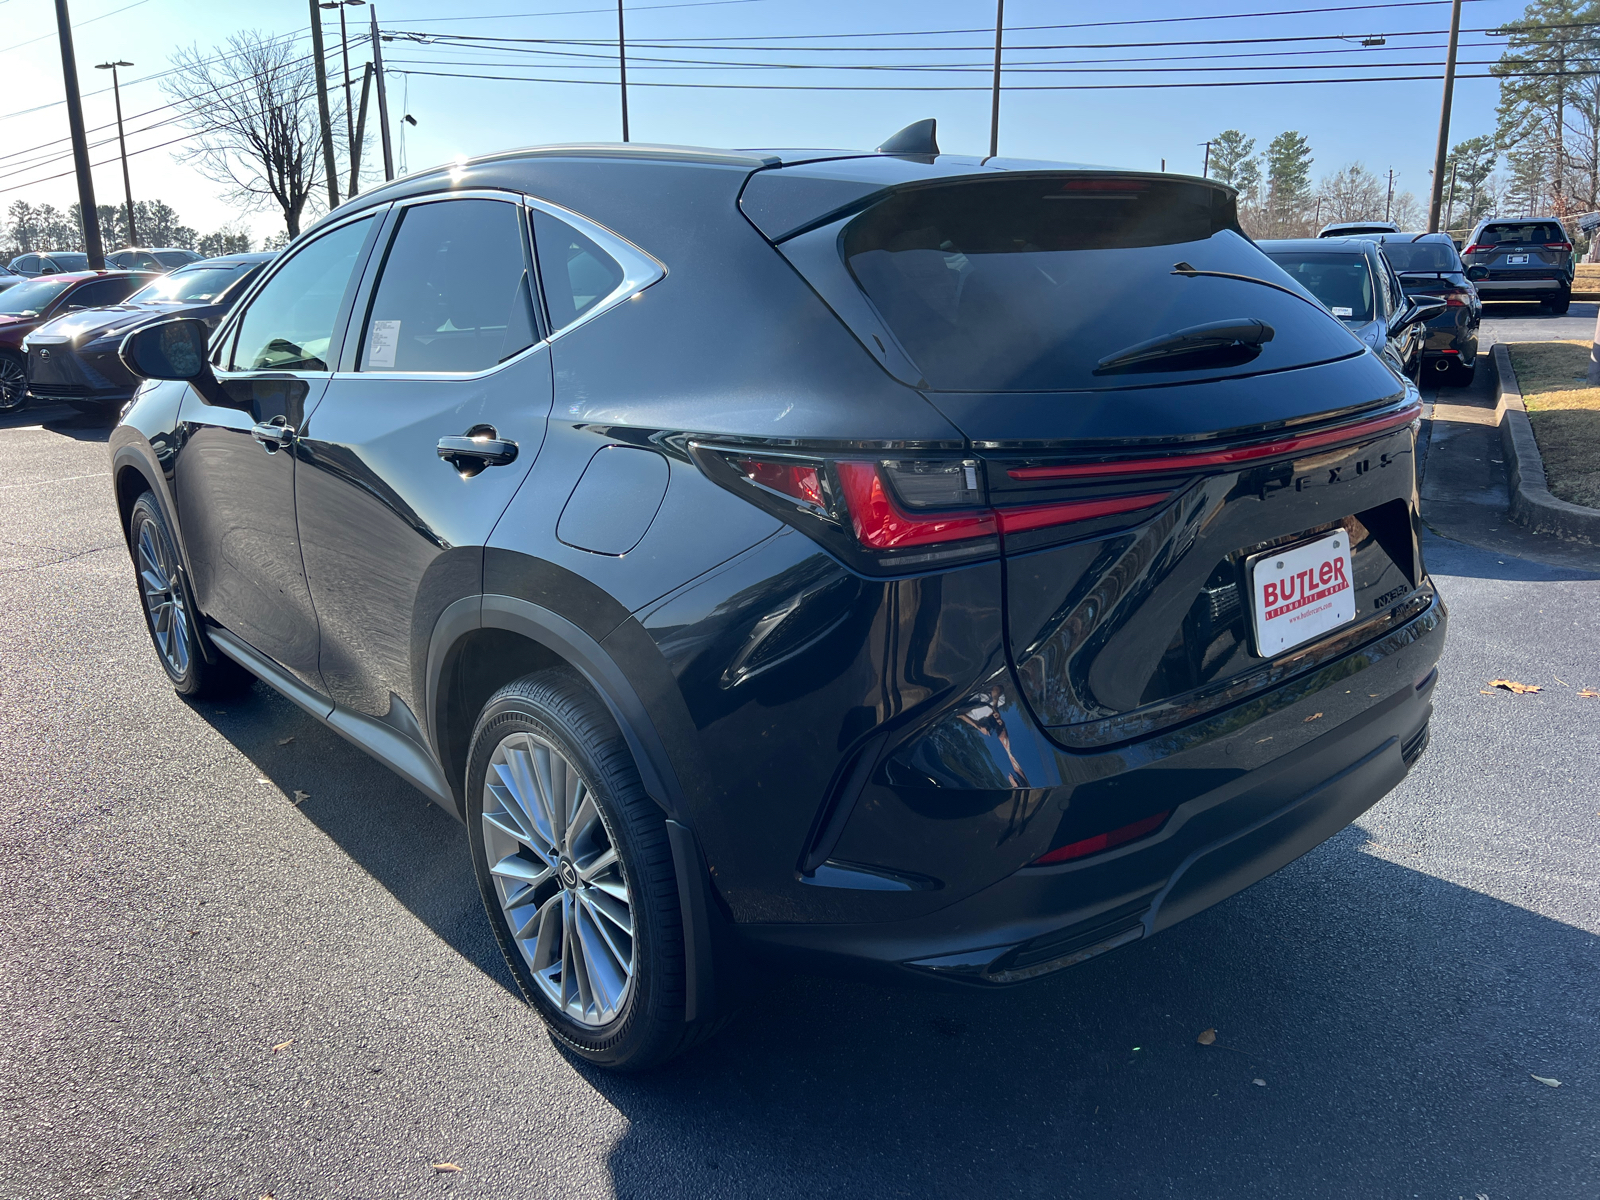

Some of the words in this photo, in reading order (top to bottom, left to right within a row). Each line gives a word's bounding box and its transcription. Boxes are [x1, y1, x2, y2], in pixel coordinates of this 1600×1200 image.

[1263, 556, 1348, 608] BUTLER
[1265, 593, 1318, 619] AUTOMOTIVE
[1324, 580, 1348, 597] GROUP
